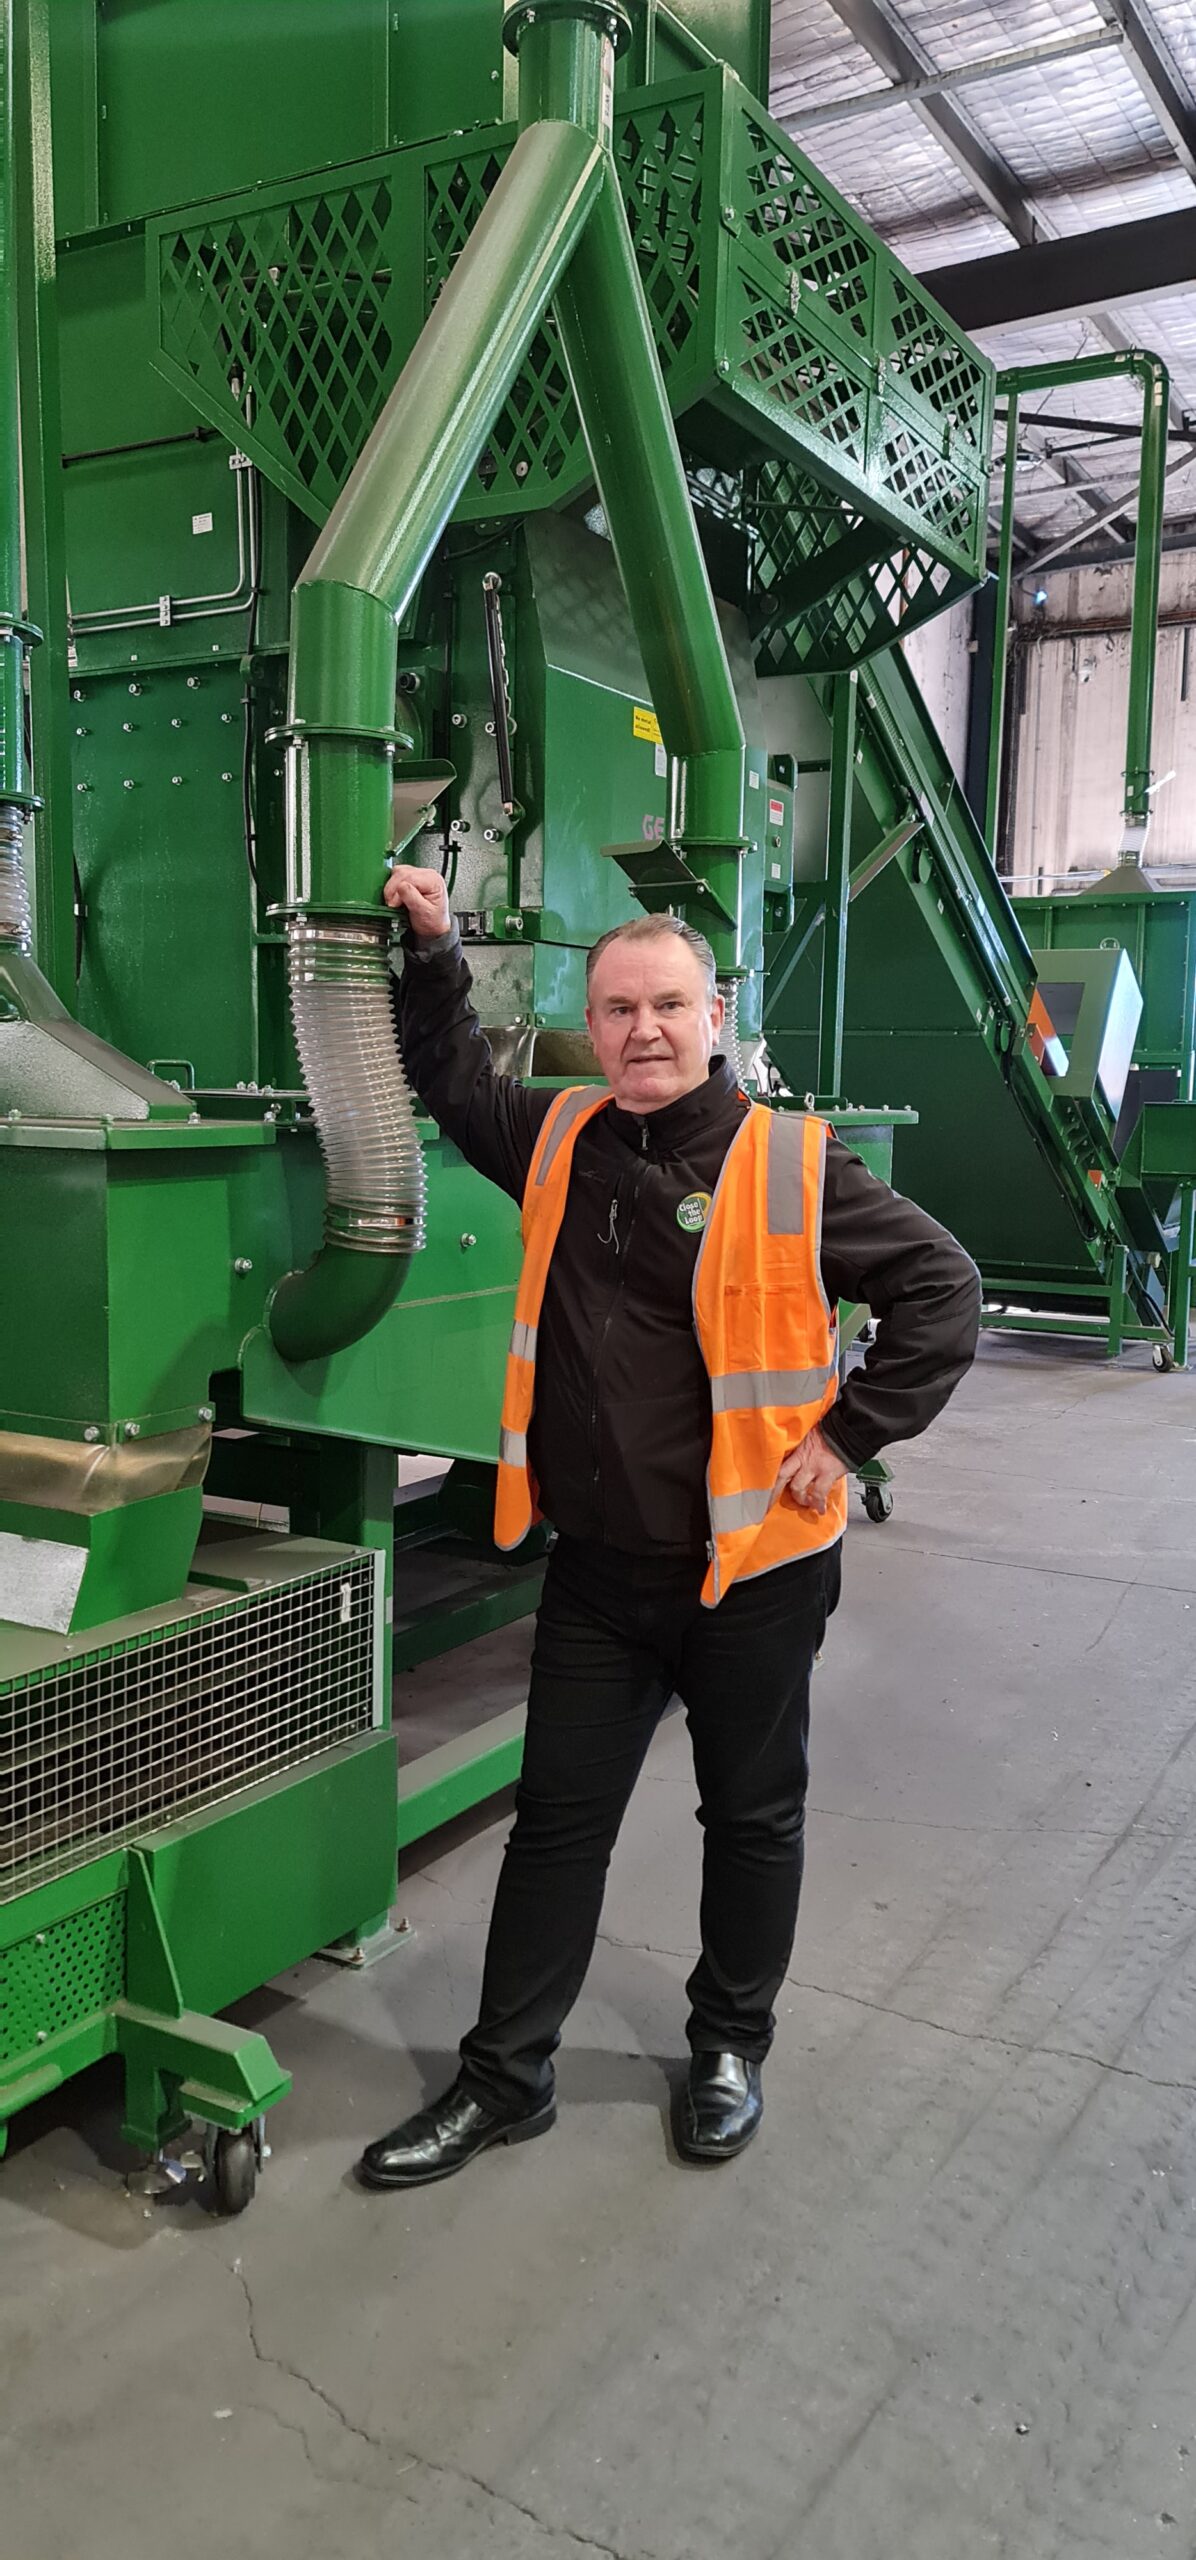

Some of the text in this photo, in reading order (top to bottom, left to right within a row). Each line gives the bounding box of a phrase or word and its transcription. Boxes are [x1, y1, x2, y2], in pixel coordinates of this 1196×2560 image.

[679, 1202, 698, 1212] Close
[688, 1208, 701, 1217] the
[684, 1215, 703, 1225] Loop
